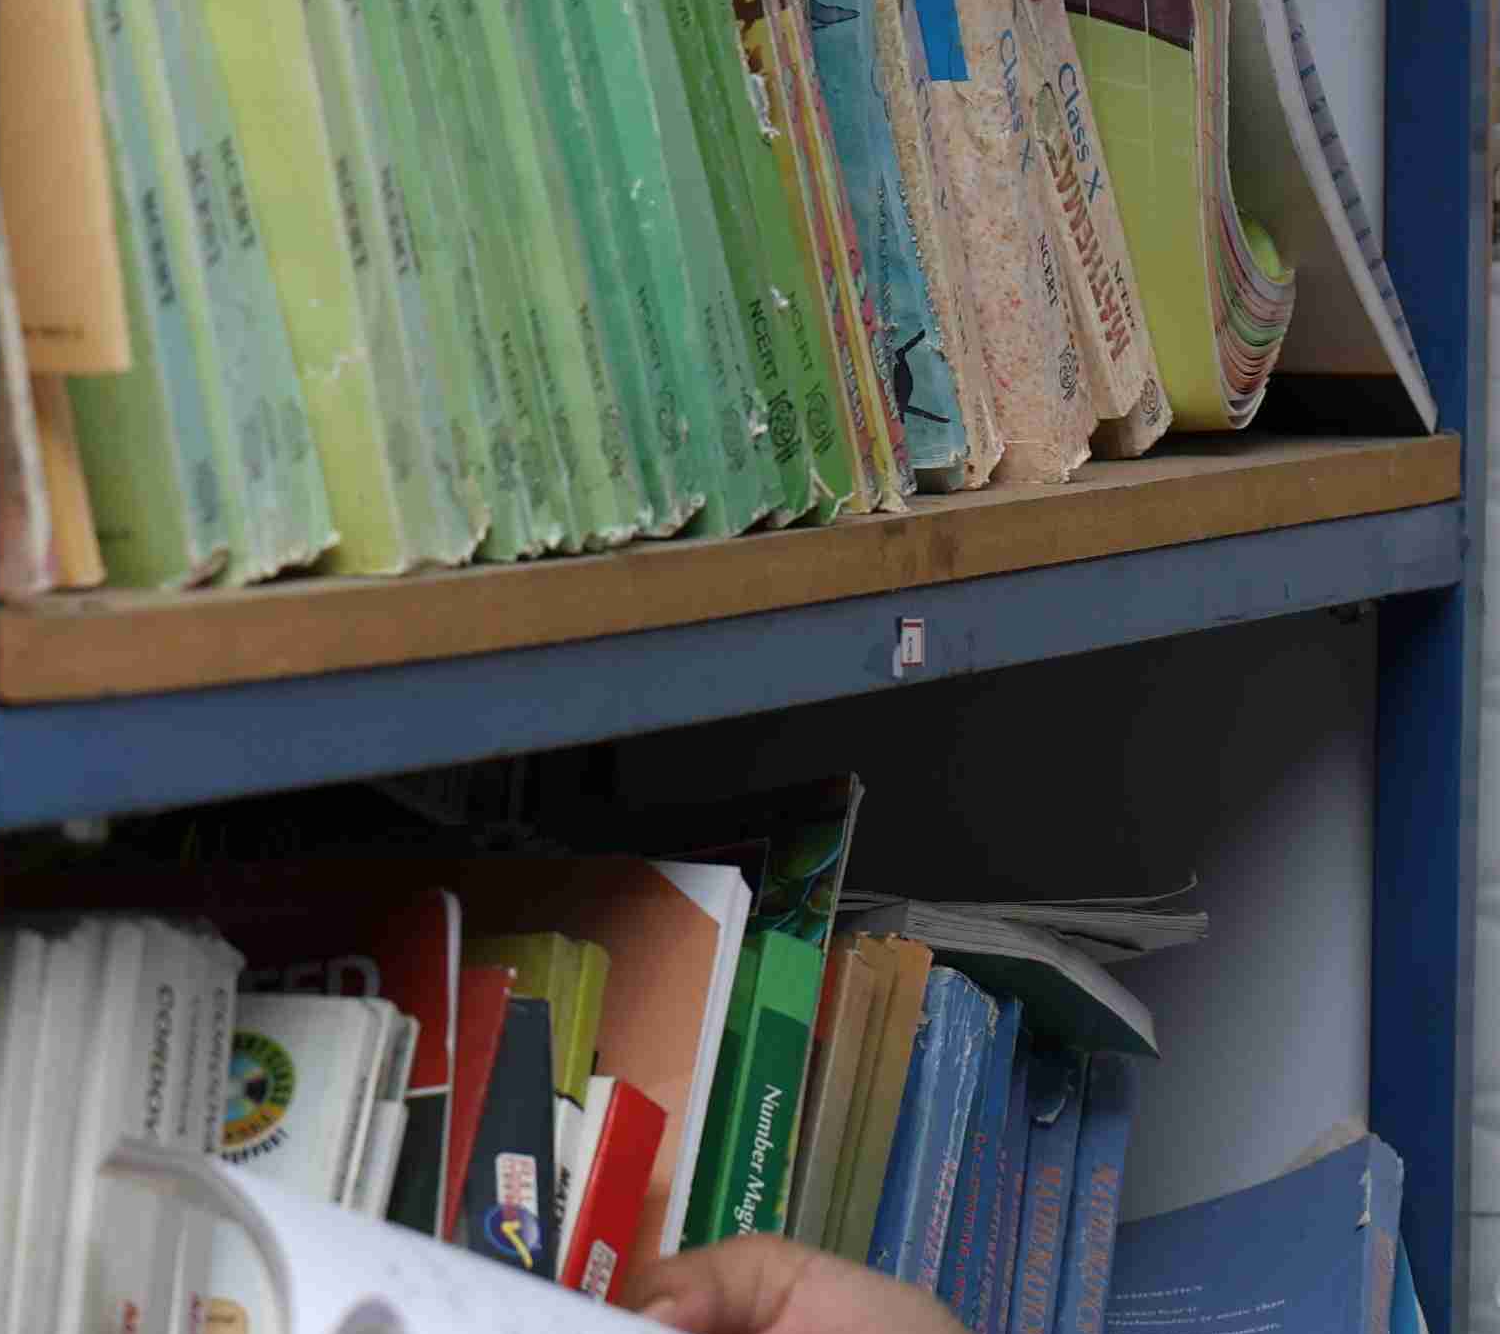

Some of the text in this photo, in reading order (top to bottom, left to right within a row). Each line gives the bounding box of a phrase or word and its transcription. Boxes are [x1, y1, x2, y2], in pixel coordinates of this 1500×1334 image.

[998, 28, 1036, 174] Class X
[1057, 62, 1105, 204] Class X
[1037, 234, 1062, 309] NCERT
[748, 298, 780, 382] NCERT
[784, 291, 814, 372] NCERT
[734, 1083, 784, 1237] Number Magi
